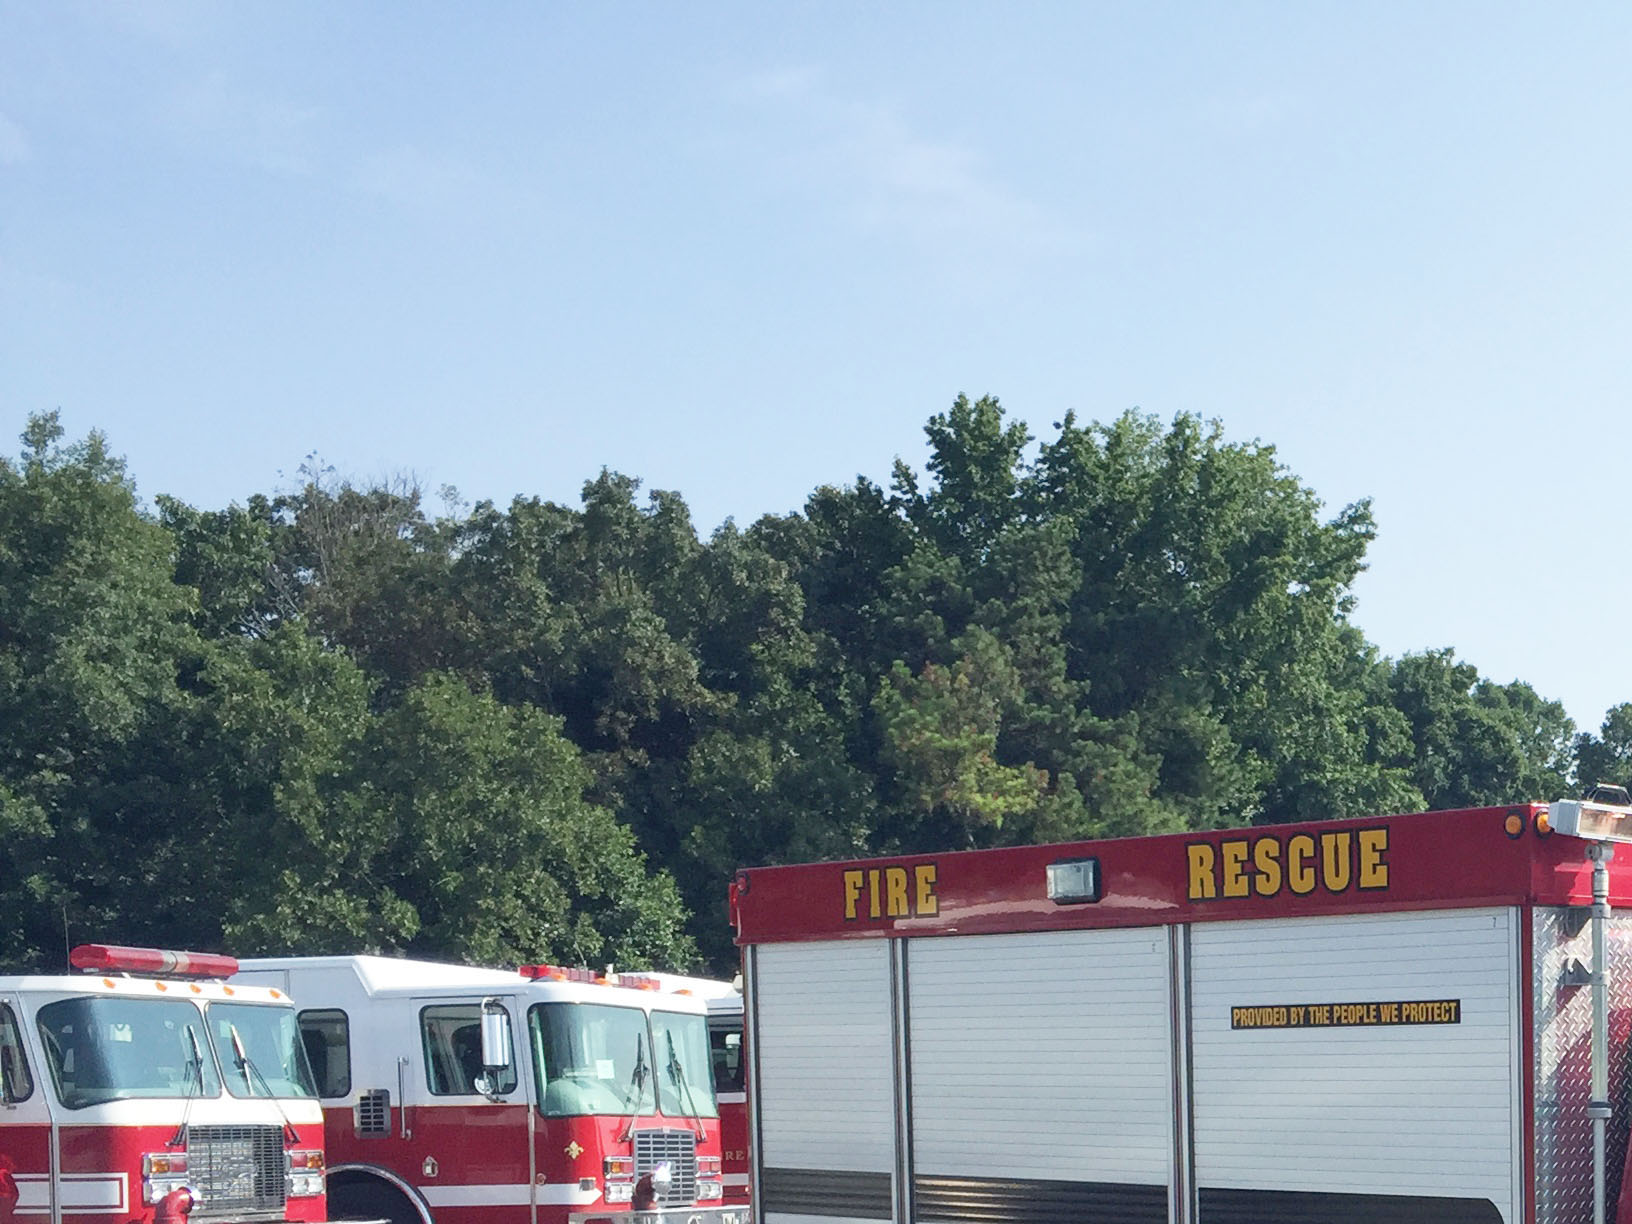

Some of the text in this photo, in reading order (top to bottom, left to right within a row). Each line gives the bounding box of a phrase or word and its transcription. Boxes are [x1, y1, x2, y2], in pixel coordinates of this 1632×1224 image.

[842, 863, 940, 920] FIRE
[1186, 827, 1390, 901] RESCUE
[1233, 1002, 1457, 1027] PROVIDED BY THE PEOPLE WE PROTECT
